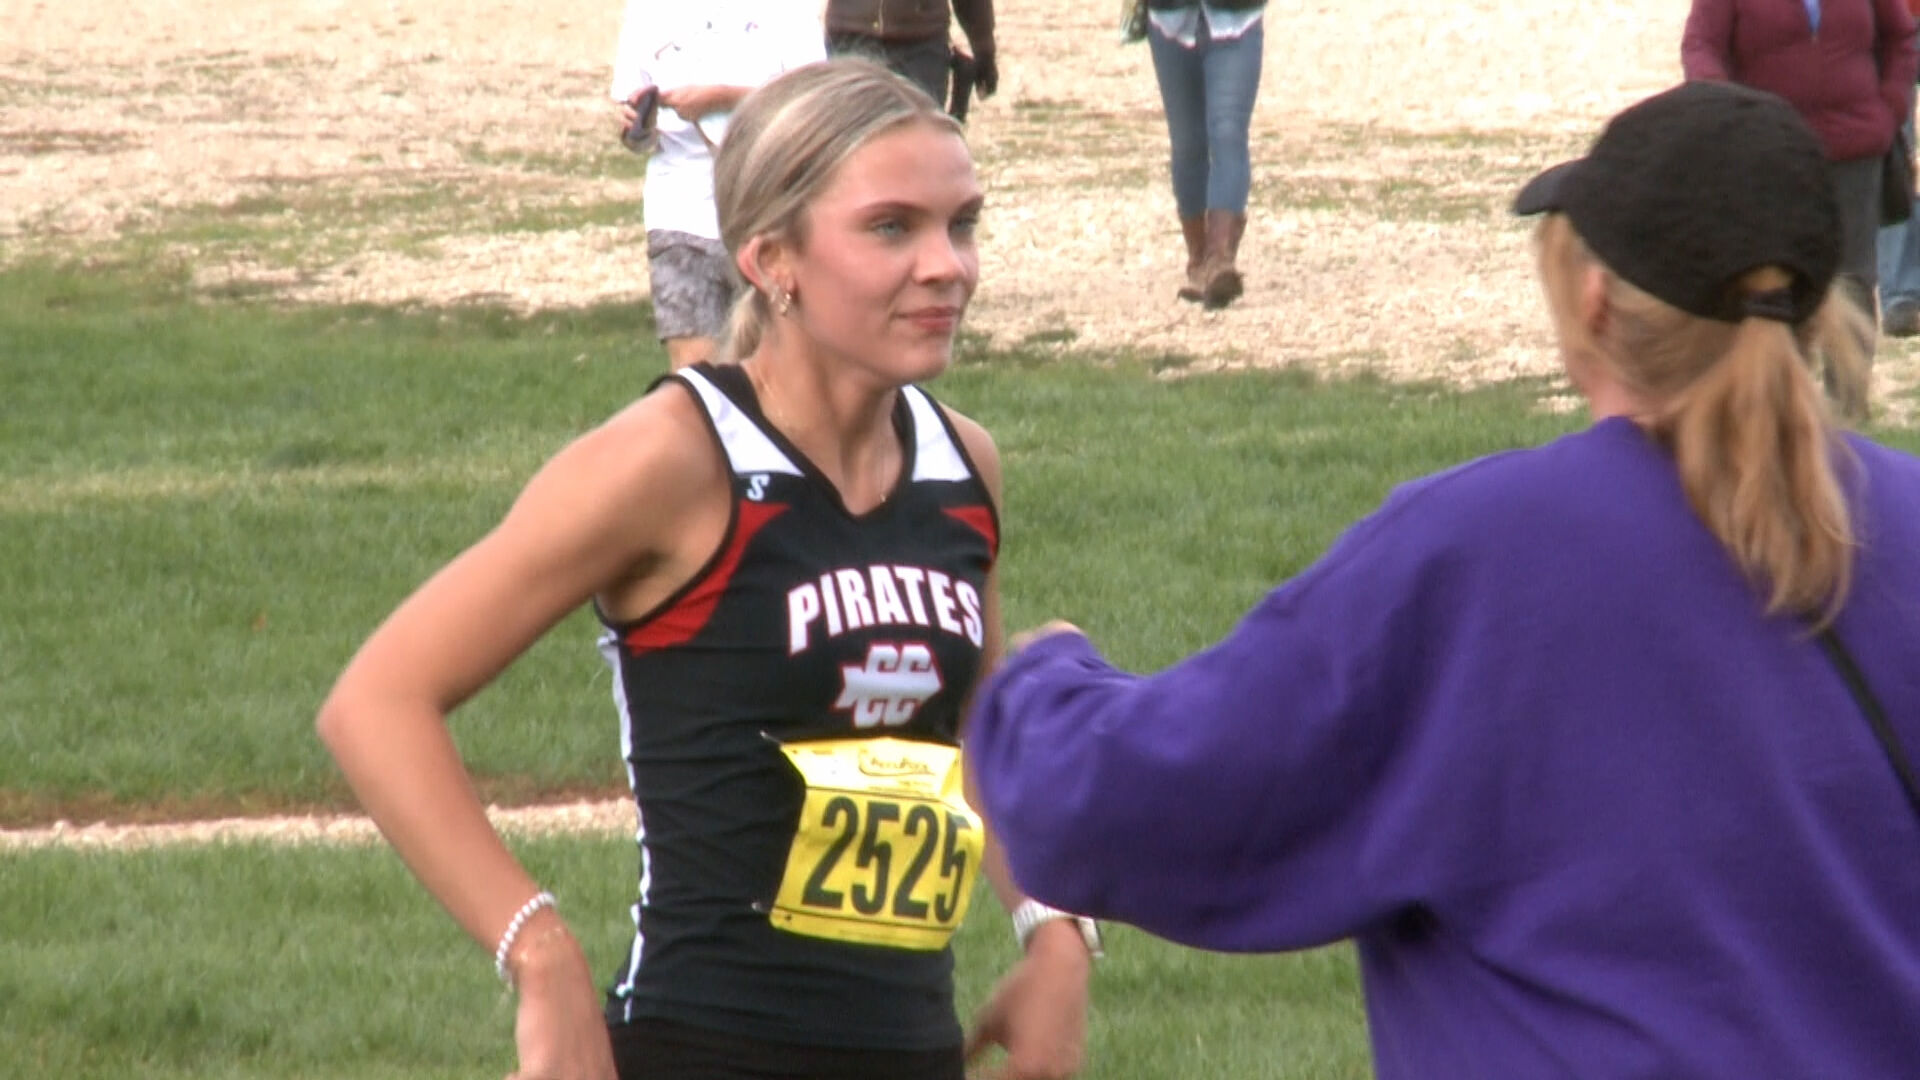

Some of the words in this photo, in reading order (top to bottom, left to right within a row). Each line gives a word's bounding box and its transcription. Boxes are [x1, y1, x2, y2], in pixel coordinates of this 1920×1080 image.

[746, 473, 770, 502] S
[787, 564, 984, 655] PIRATES
[800, 795, 971, 924] 2525
